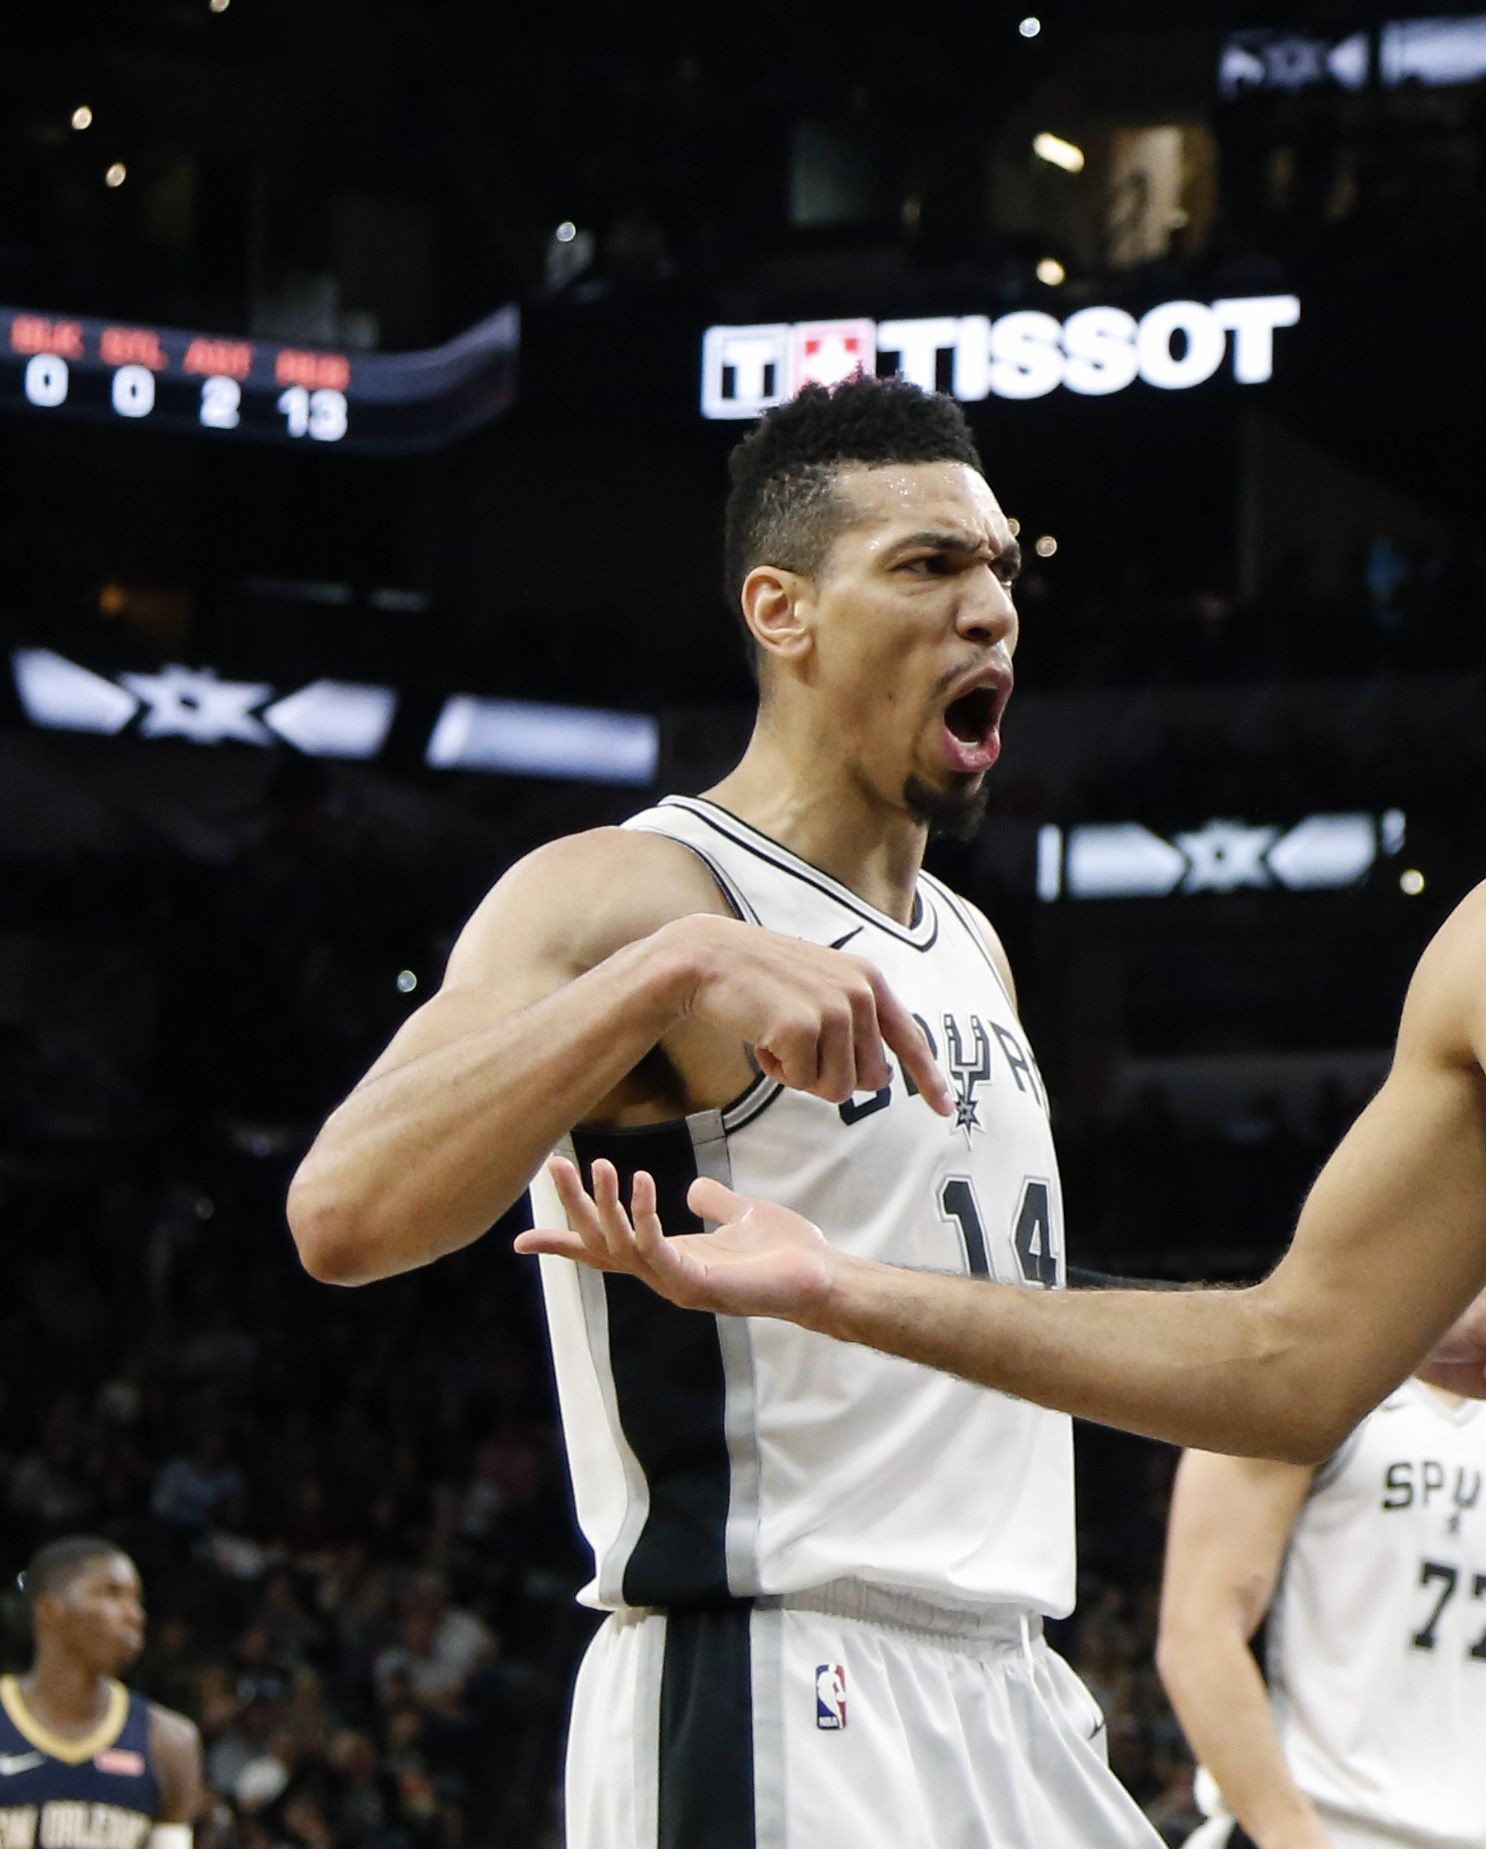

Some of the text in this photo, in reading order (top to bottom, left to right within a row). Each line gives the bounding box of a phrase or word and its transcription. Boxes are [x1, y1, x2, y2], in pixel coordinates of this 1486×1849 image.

[25, 352, 348, 442] 0 0 2 13
[876, 294, 1300, 400] TISSOT
[936, 1174, 1064, 1290] 14
